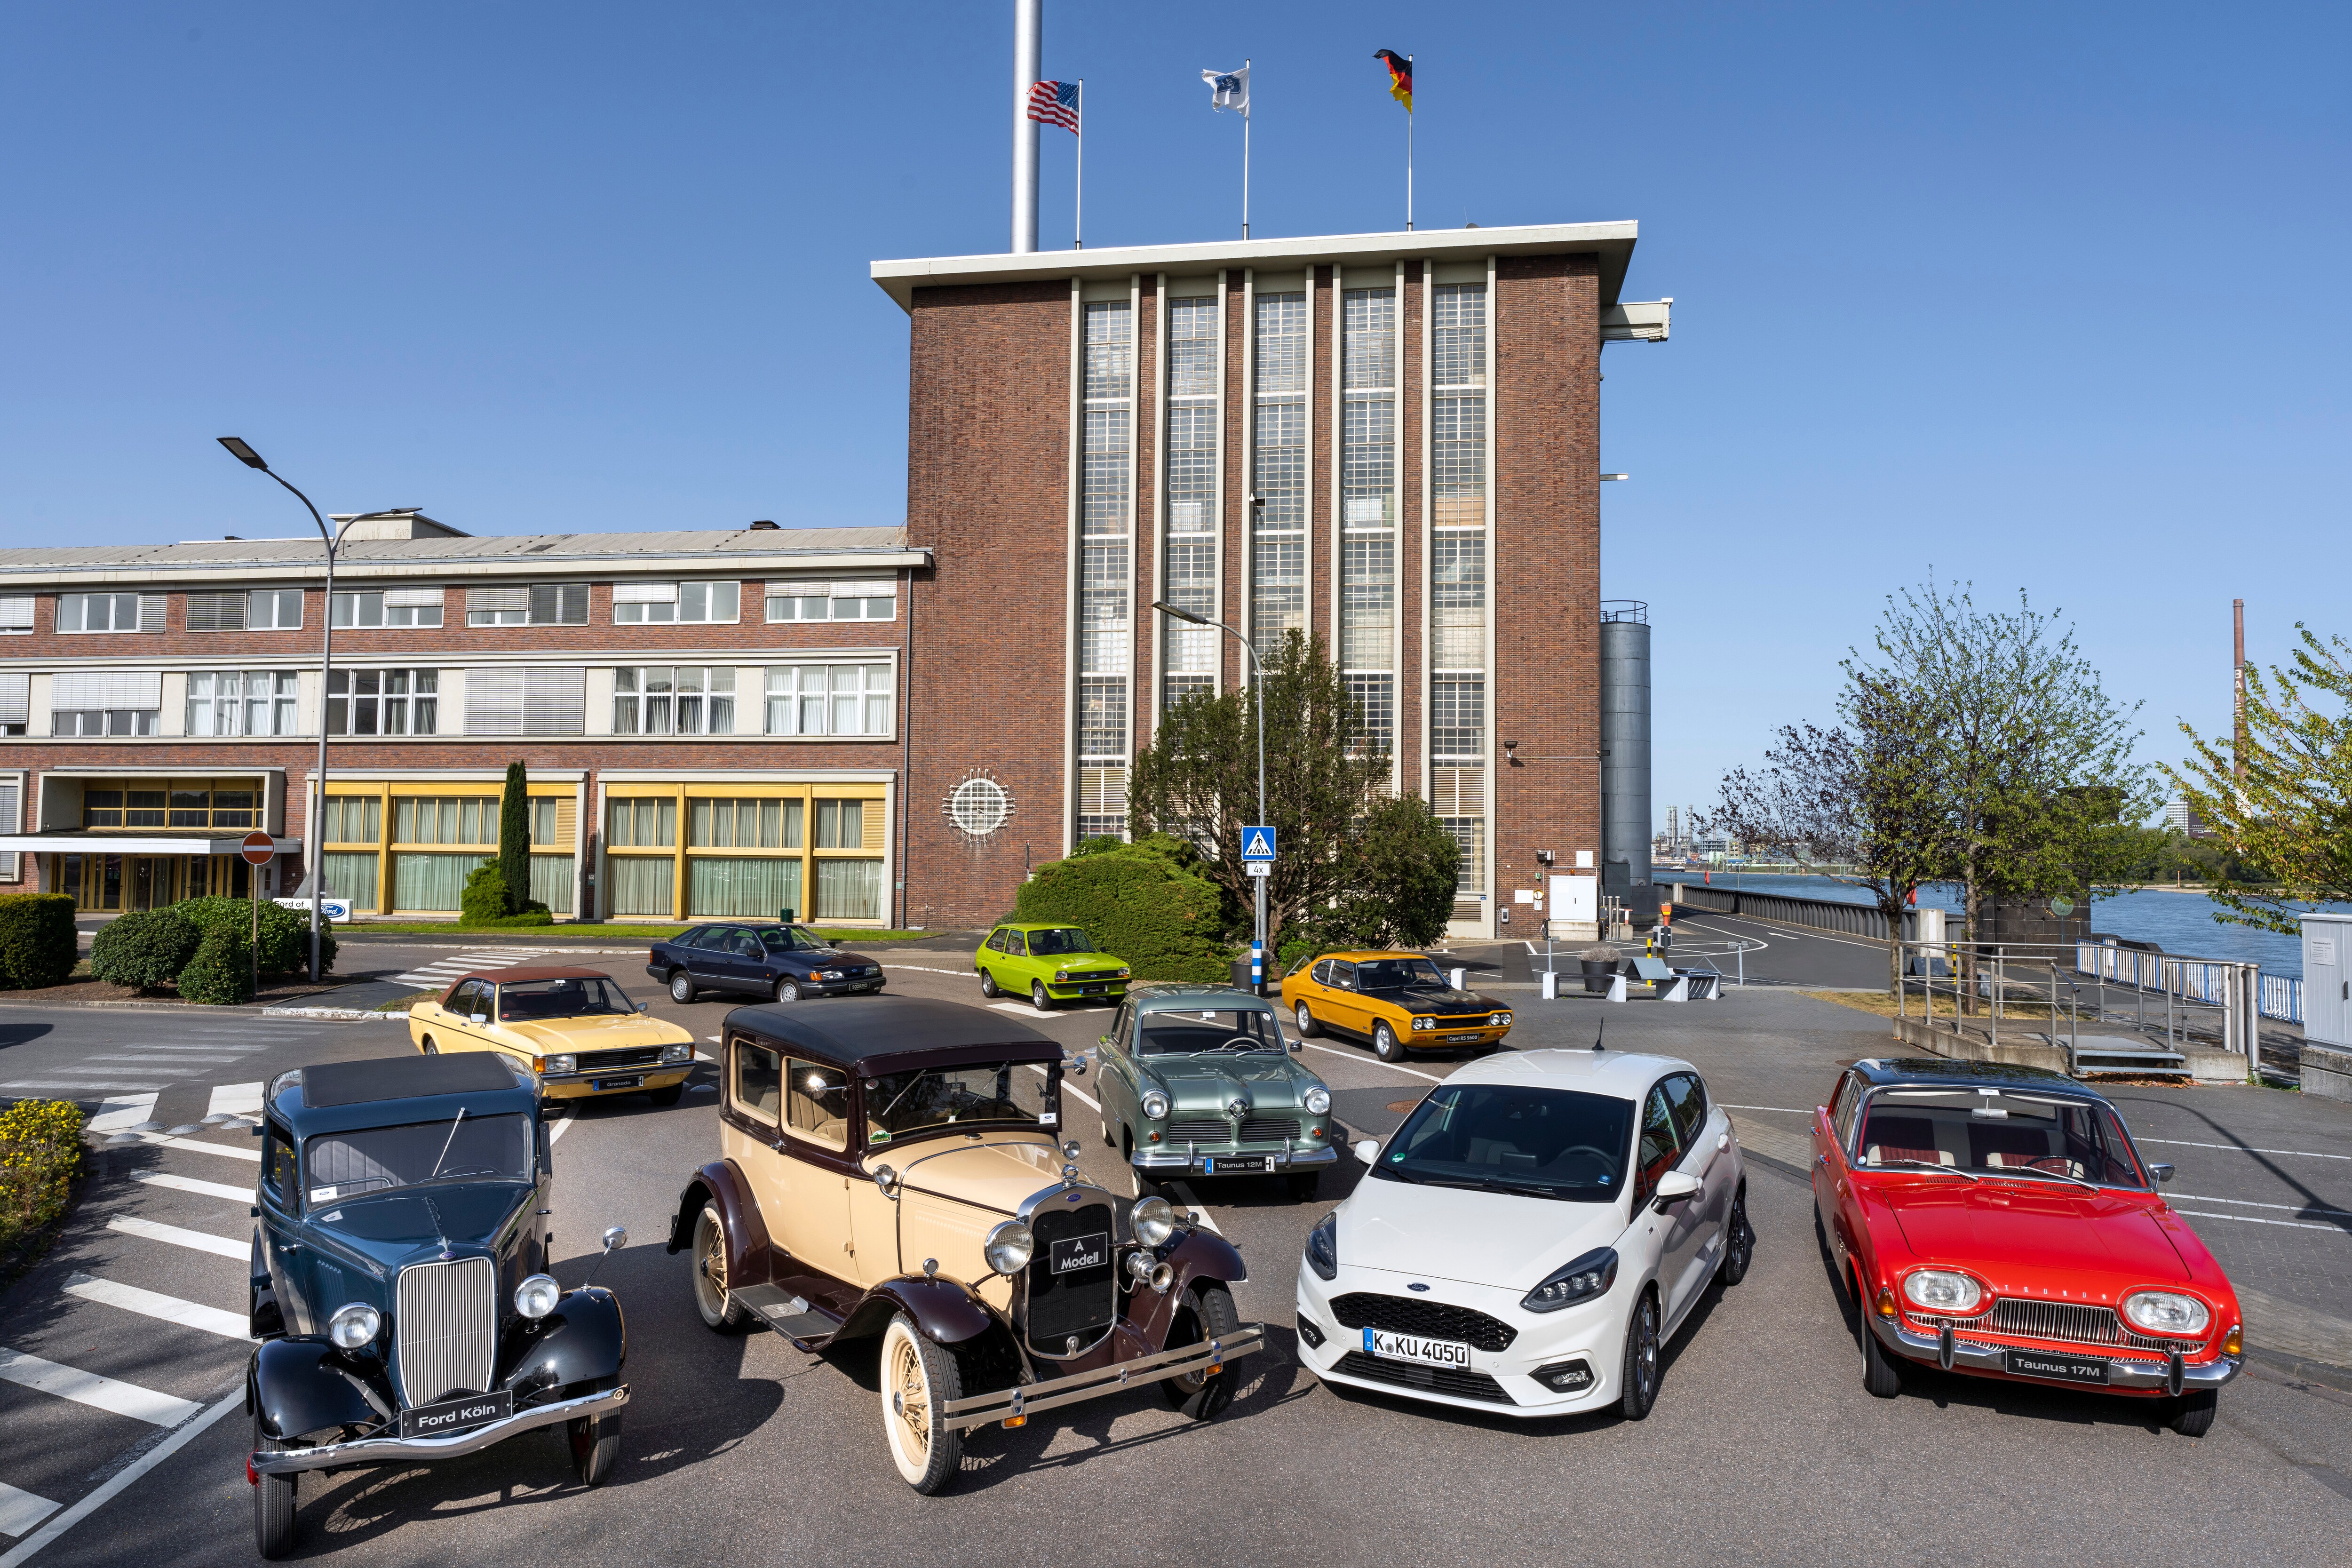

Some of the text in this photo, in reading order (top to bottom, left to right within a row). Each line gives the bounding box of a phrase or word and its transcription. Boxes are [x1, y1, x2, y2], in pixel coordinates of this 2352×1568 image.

[1074, 1240, 1084, 1252] A
[1061, 1251, 1099, 1270] Modell
[1374, 1332, 1465, 1364] K KU 4050
[2015, 1358, 2099, 1377] Taunus 17M
[419, 1405, 495, 1427] Ford Köln
